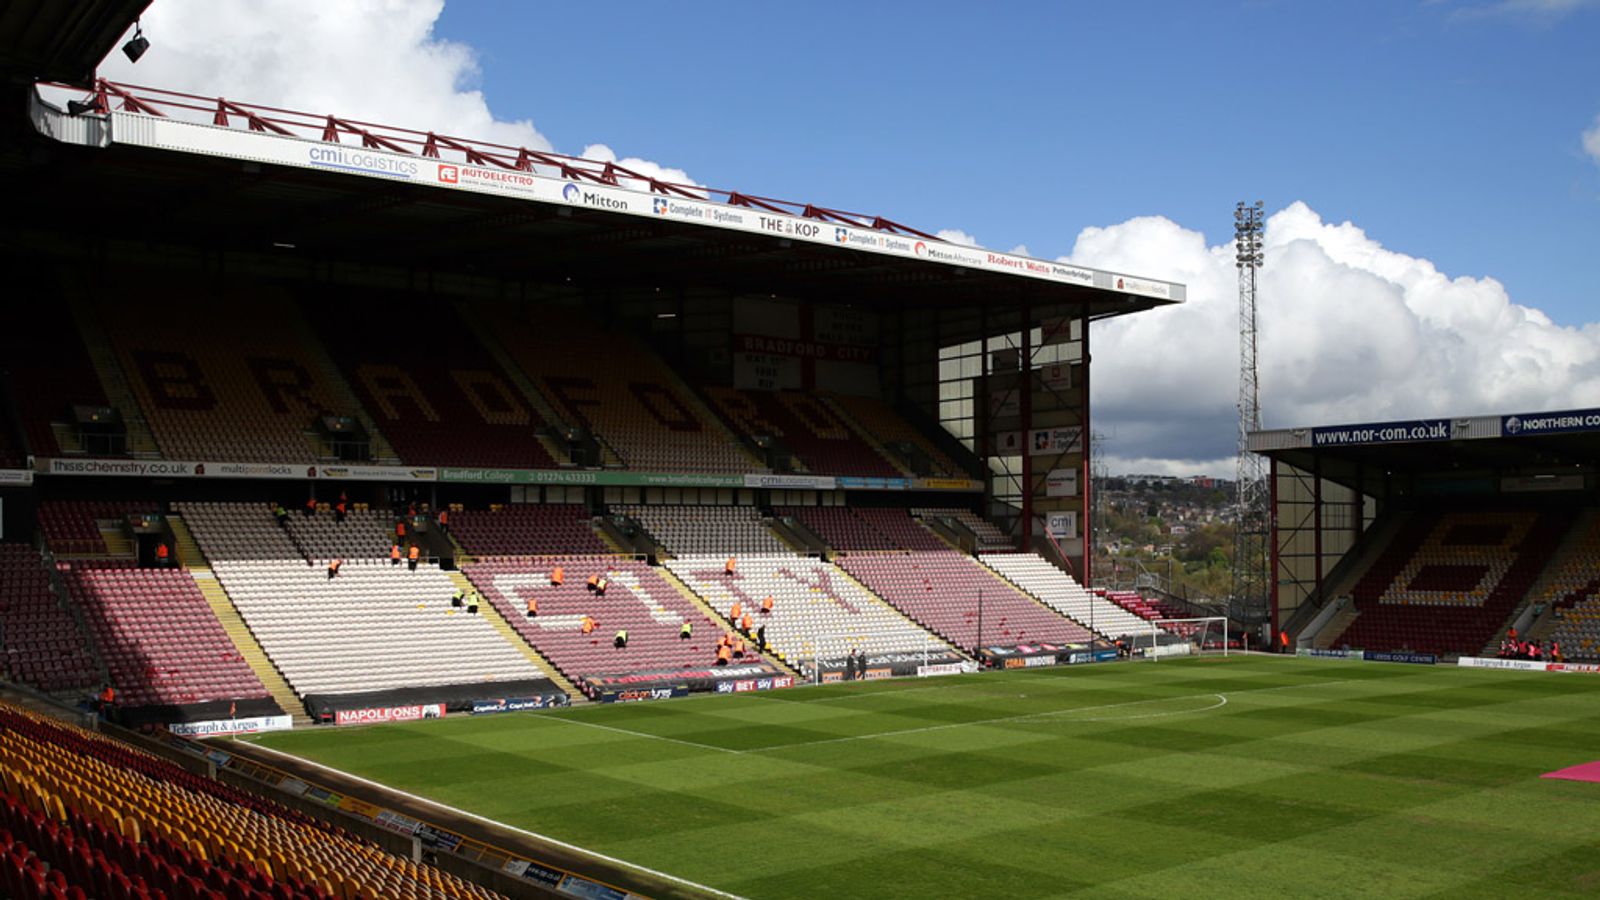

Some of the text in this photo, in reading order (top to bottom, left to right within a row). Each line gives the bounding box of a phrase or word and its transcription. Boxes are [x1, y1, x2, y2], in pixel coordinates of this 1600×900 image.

[462, 168, 534, 186] AUTOELECTRO
[584, 192, 628, 210] Mitton
[669, 203, 703, 219] Complete
[713, 210, 743, 224] Systems
[759, 217, 820, 238] THE KOP
[849, 232, 877, 246] Complete
[886, 239, 910, 251] Systems
[928, 249, 953, 260] Mitton
[987, 254, 1050, 273] Robert Watts
[744, 337, 826, 357] BRADFORD
[837, 346, 871, 360] CITY
[1523, 416, 1583, 430] NORTHERN
[1315, 422, 1447, 444] www.nor-com.co.uk
[54, 461, 188, 475] thisischemistry.co.uk
[443, 470, 482, 480] Bradford
[484, 470, 515, 482] College
[1051, 514, 1072, 528] cmi
[718, 677, 791, 693] sky BET sky BET
[340, 706, 420, 721] NAPOLEONS
[172, 721, 218, 734] Telegraph
[220, 722, 228, 731] &
